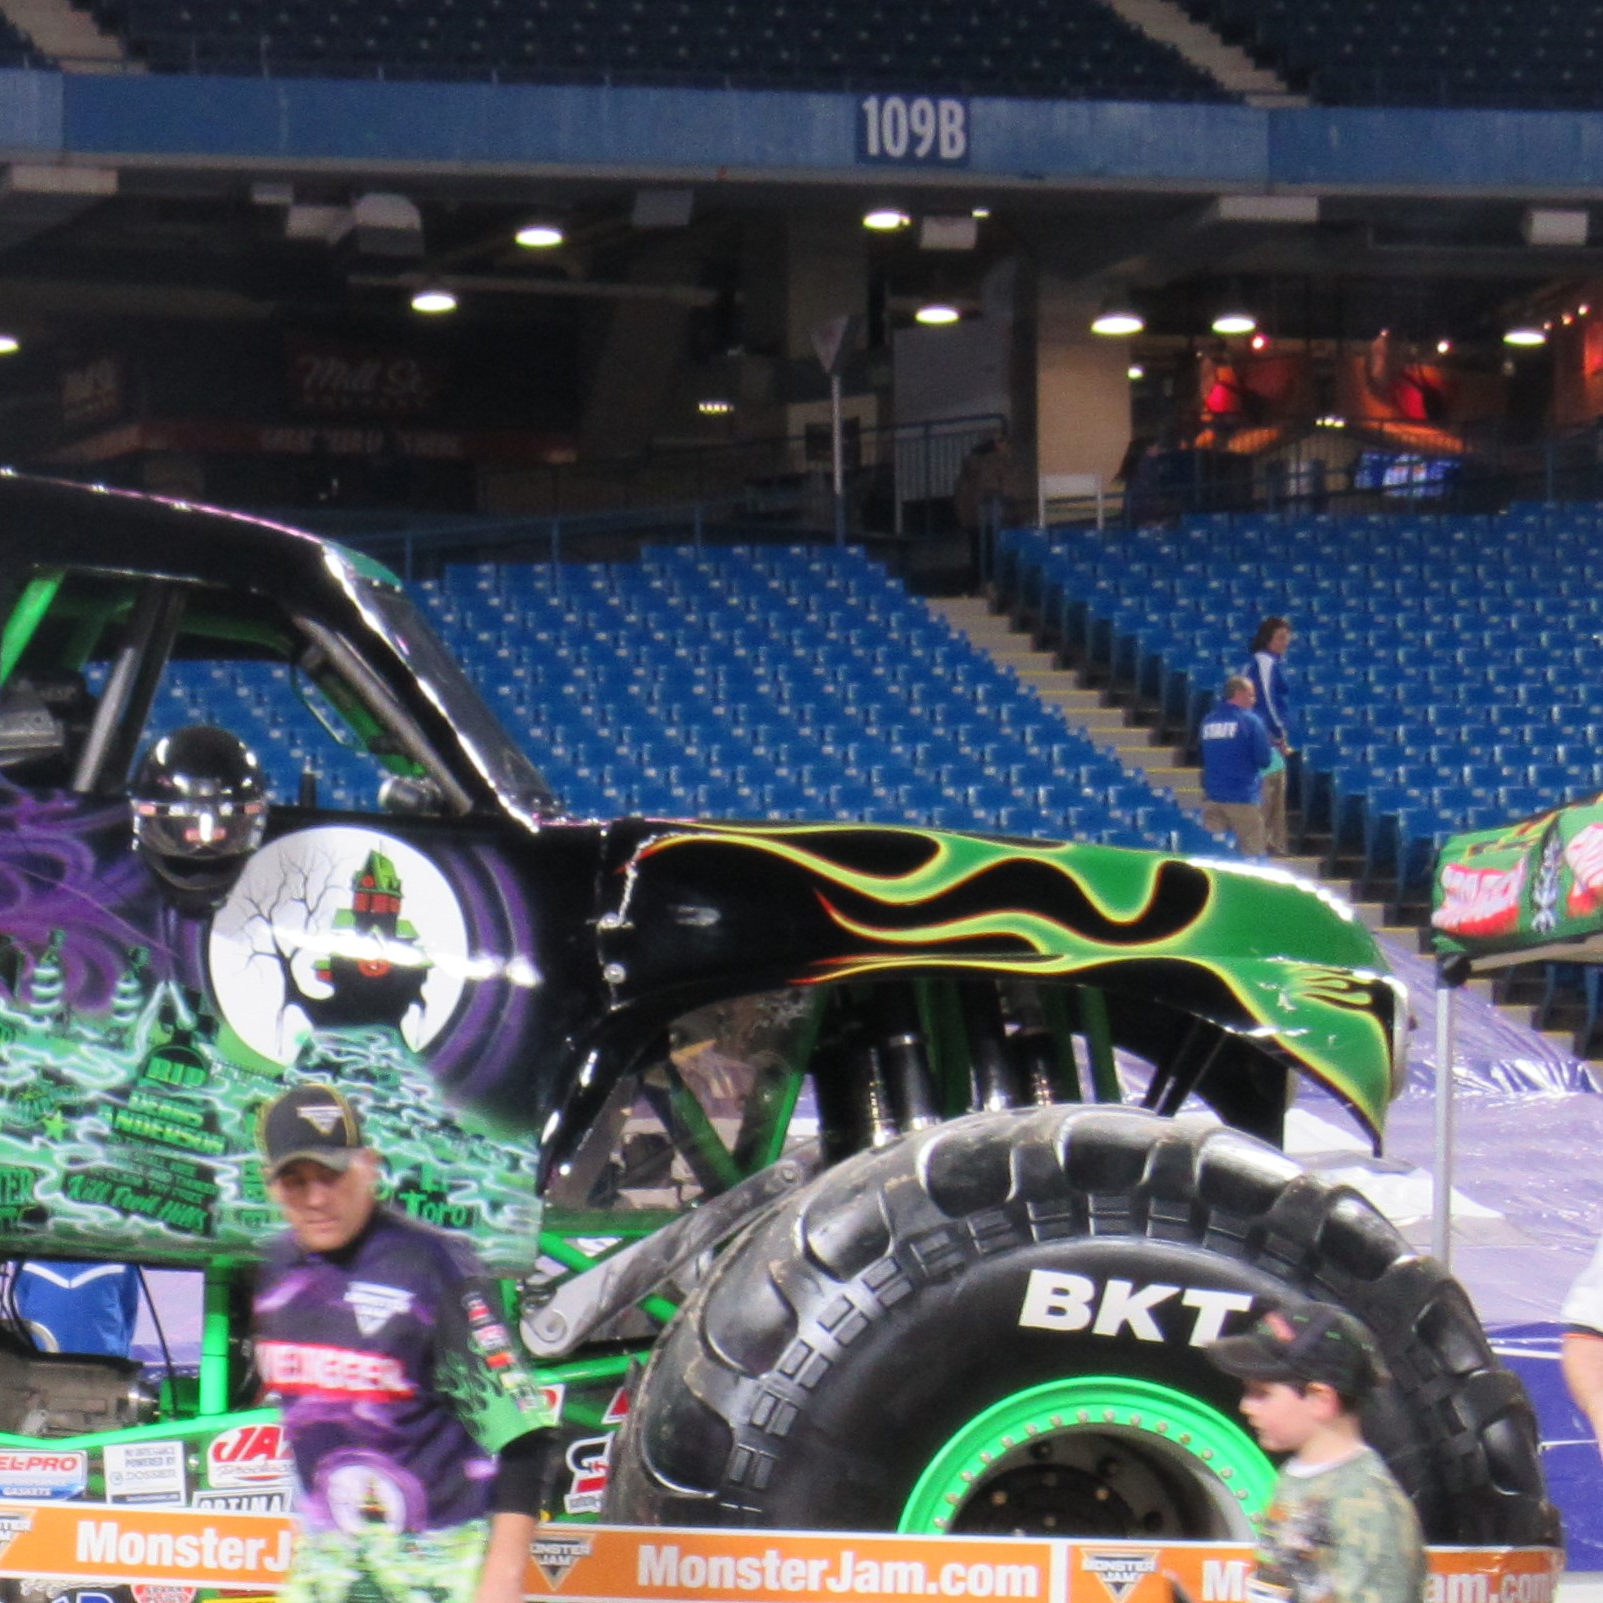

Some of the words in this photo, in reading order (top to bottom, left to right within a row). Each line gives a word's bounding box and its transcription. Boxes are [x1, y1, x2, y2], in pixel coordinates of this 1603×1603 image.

[862, 96, 968, 159] 109B
[1018, 1268, 1253, 1348] BKT
[212, 1426, 294, 1463] JA
[637, 1544, 1039, 1598] MonsterJam.com
